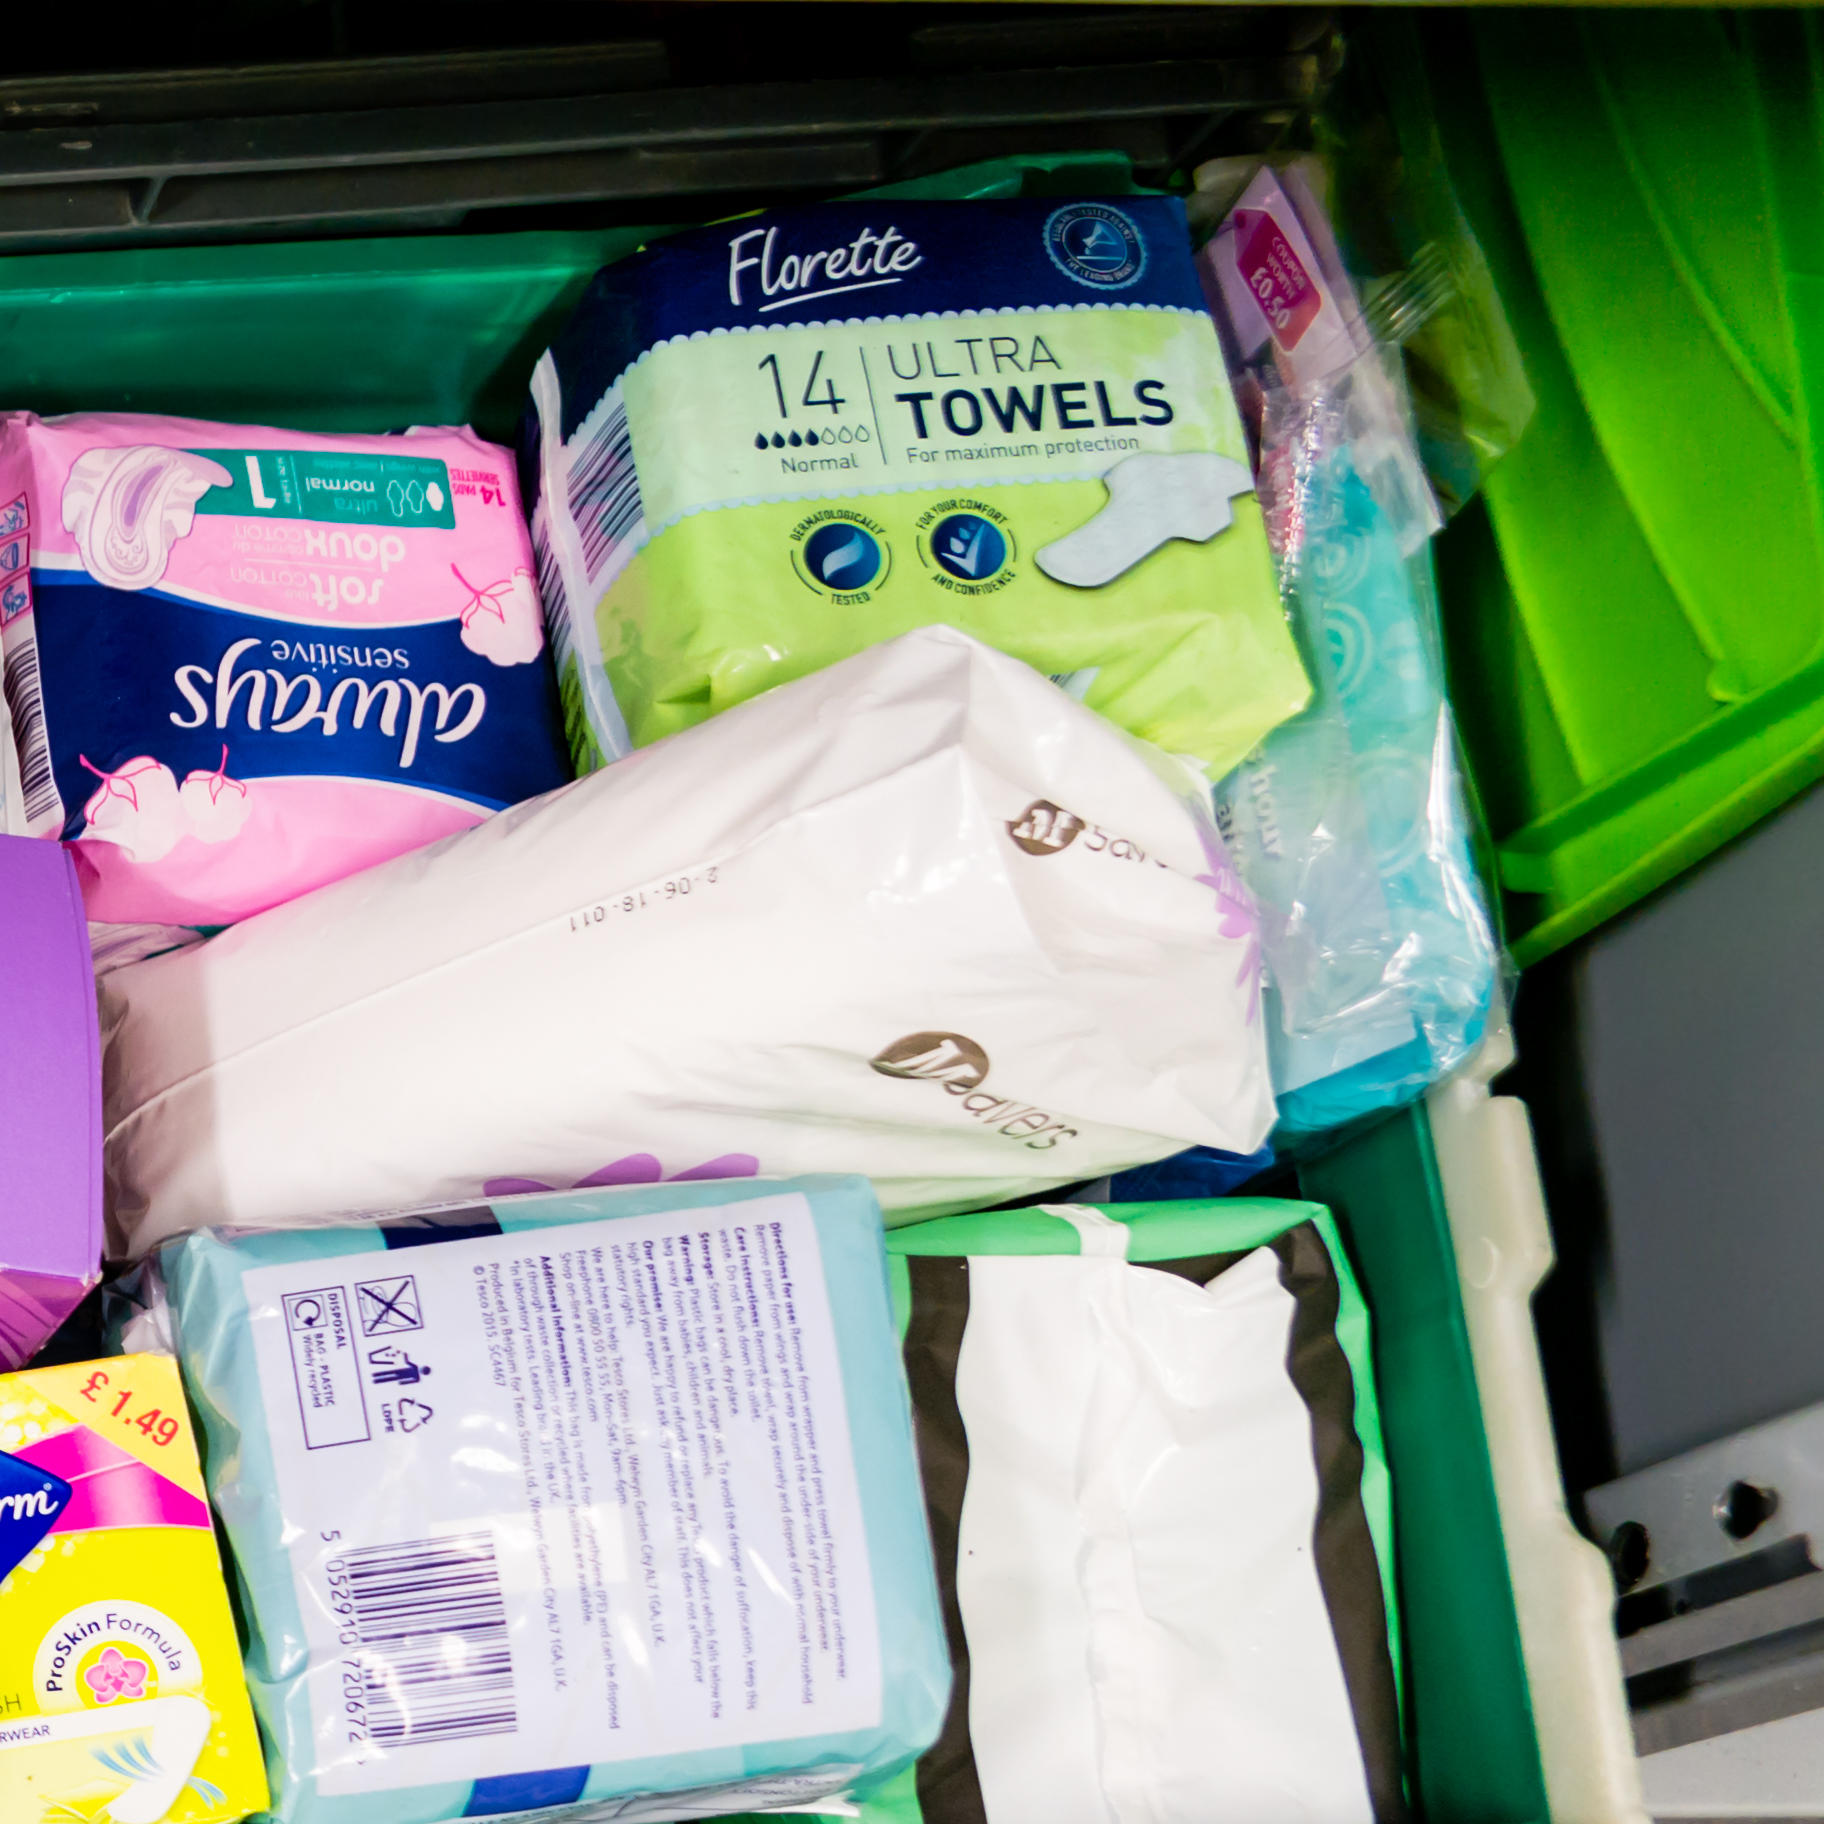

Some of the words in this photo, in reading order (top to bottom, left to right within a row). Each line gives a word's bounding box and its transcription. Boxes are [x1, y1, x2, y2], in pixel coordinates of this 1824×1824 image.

[729, 225, 922, 306] Florette
[758, 352, 845, 419] 14
[886, 335, 1061, 381] ULTRA
[896, 378, 1175, 439] TOWELS
[781, 452, 860, 475] Normal
[907, 445, 940, 464] For
[945, 440, 1040, 461] maximum
[1046, 433, 1140, 457] protection
[245, 455, 276, 510] 1
[305, 477, 375, 494] normal
[790, 509, 885, 542] DERMATOLOGICALLY
[916, 512, 935, 530] FOR
[930, 499, 958, 515] YOUR
[959, 499, 1008, 525] COMFORT
[303, 529, 406, 572] doux
[309, 572, 384, 612] soft
[831, 591, 871, 605] TESTED
[931, 574, 954, 590] AND
[954, 568, 1017, 595] CONFIDENCE
[270, 640, 410, 673] sensitive
[169, 637, 486, 768] always
[326, 1292, 347, 1350] DISPOSAL
[80, 1369, 103, 1404] £
[106, 1389, 180, 1449] 1.49
[381, 1402, 395, 1433] LDPE
[45, 1619, 103, 1693] ProSkin
[104, 1612, 182, 1673] Formula
